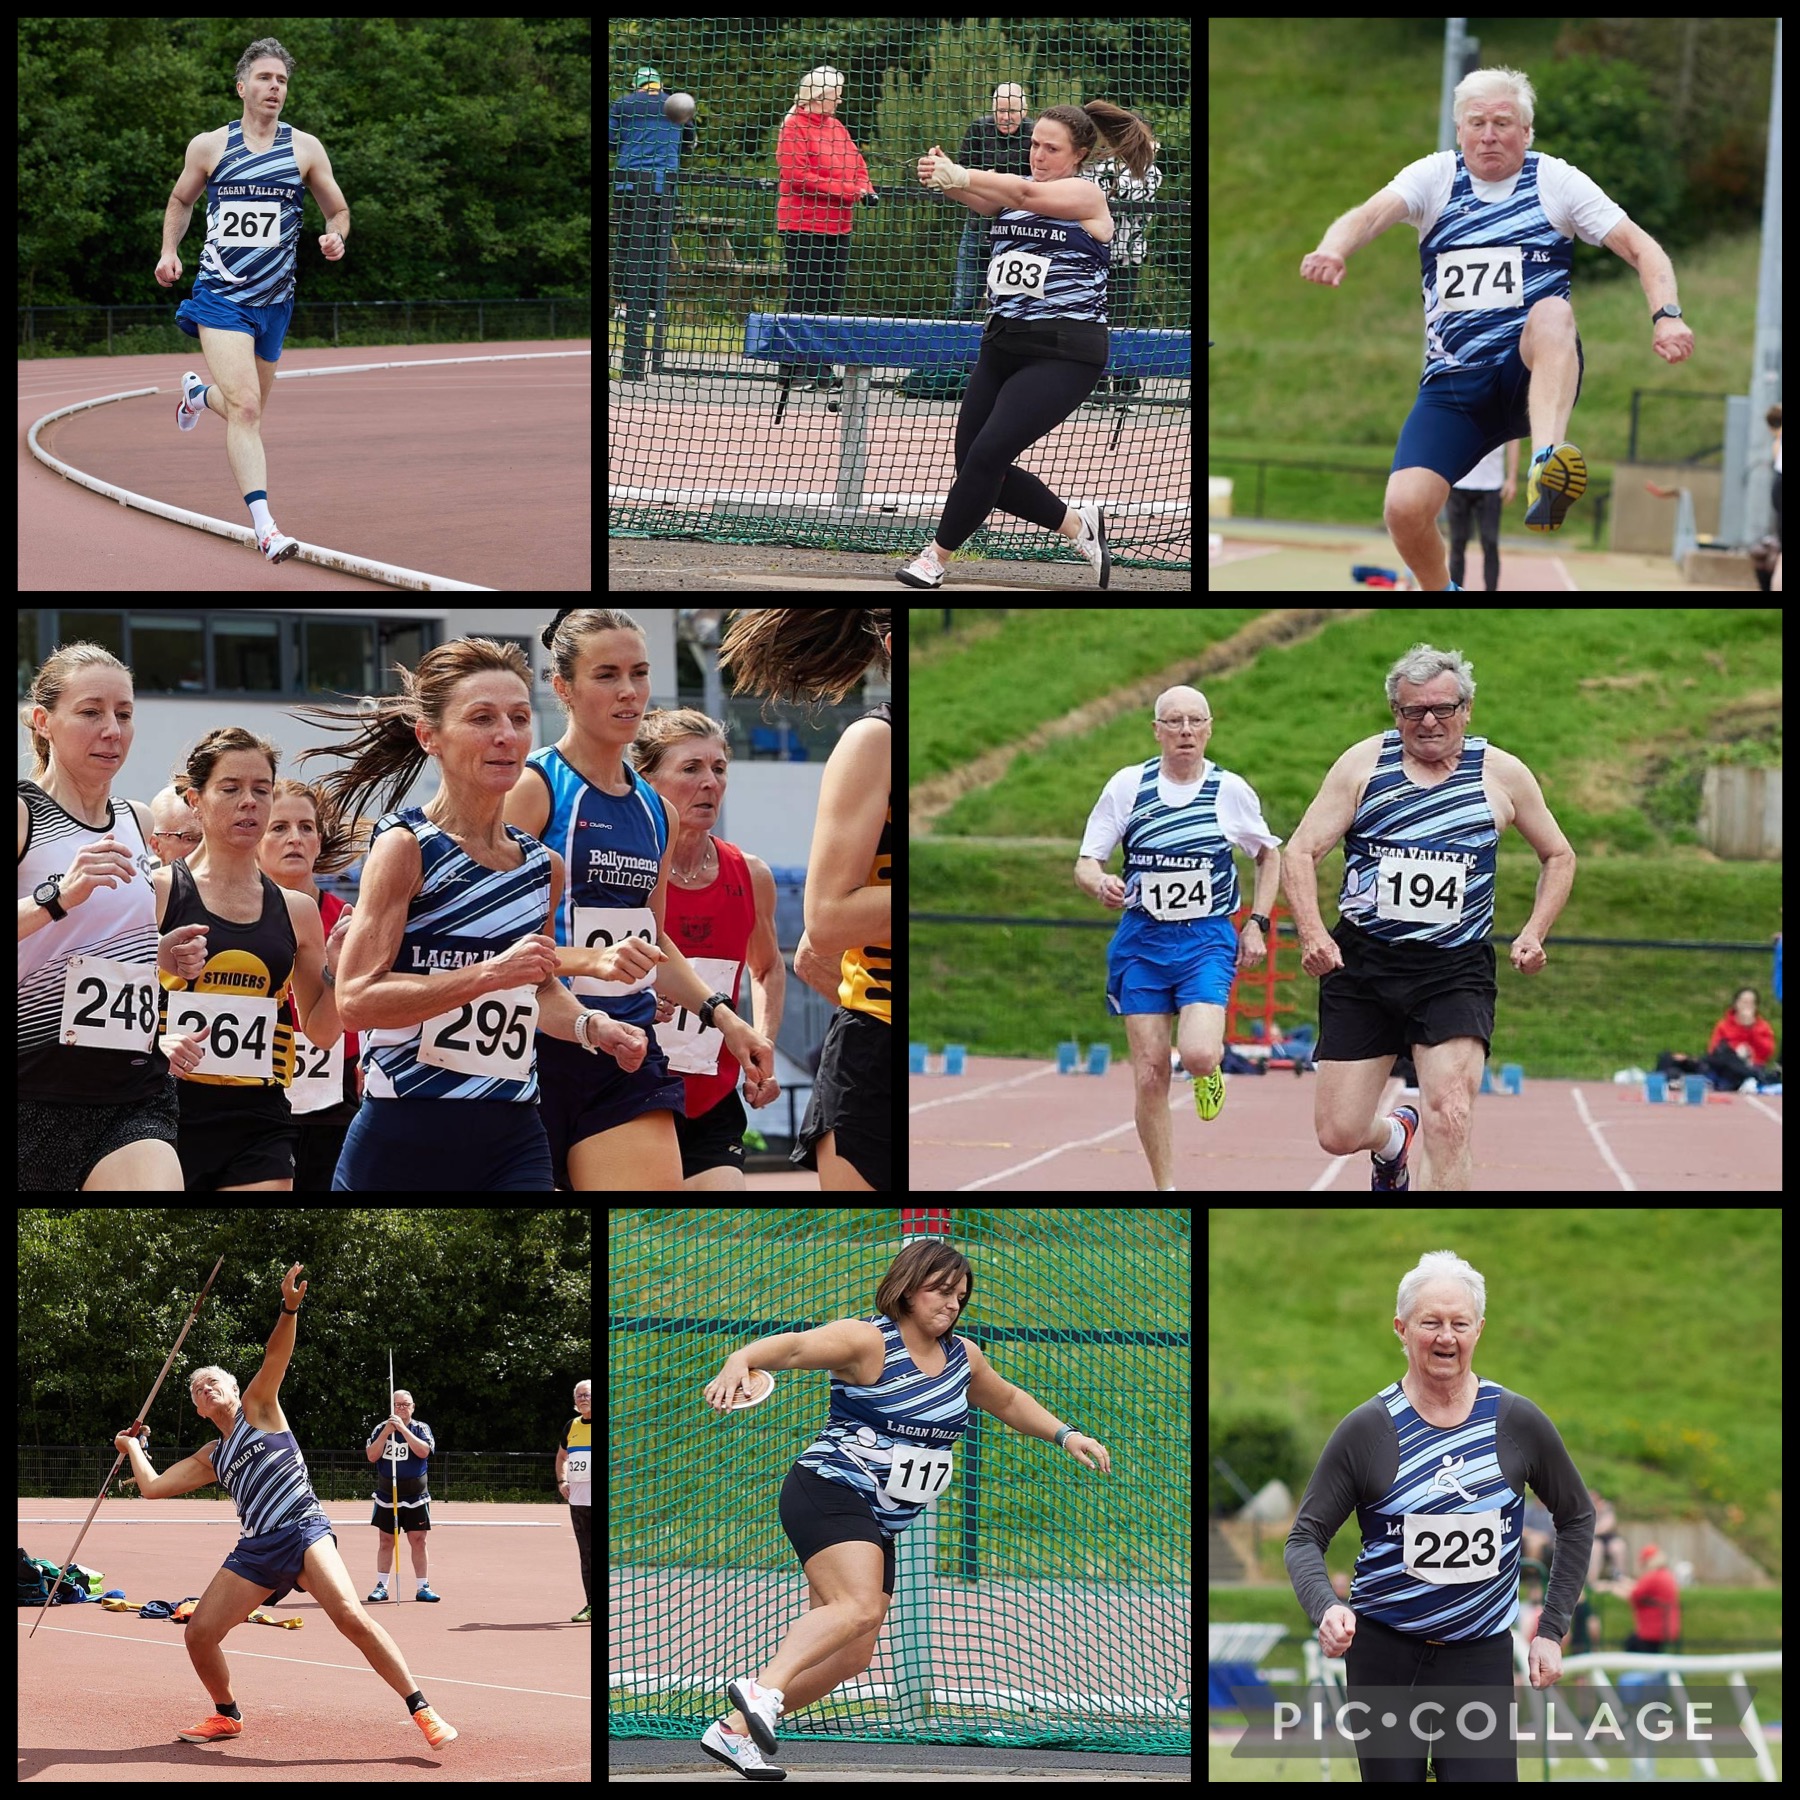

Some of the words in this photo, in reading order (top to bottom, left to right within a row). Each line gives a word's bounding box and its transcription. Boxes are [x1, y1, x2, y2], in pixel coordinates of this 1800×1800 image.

[217, 186, 246, 196] LAGAN
[248, 184, 285, 196] VALLEY
[222, 211, 277, 238] 267
[1010, 225, 1048, 239] VALLEY
[1049, 229, 1067, 243] AC
[1531, 250, 1551, 262] AC
[996, 260, 1042, 289] 183
[1444, 260, 1516, 299] 274
[589, 849, 658, 873] Ballymena
[1155, 854, 1199, 869] VALLEY
[1368, 842, 1405, 859] LAGAN
[1407, 846, 1461, 863] VALLEY
[587, 868, 657, 890] runners
[1387, 871, 1458, 910] 194
[1149, 880, 1207, 910] 124
[412, 945, 480, 968] LAGAN
[203, 971, 267, 990] STRIDERS
[73, 976, 155, 1034] 248
[433, 1000, 533, 1061] 295
[887, 1419, 930, 1438] LAGAN
[230, 1449, 253, 1472] VALLEY
[252, 1442, 266, 1454] AC
[569, 1460, 587, 1472] 329
[900, 1458, 949, 1492] 117
[1413, 1527, 1496, 1568] 223
